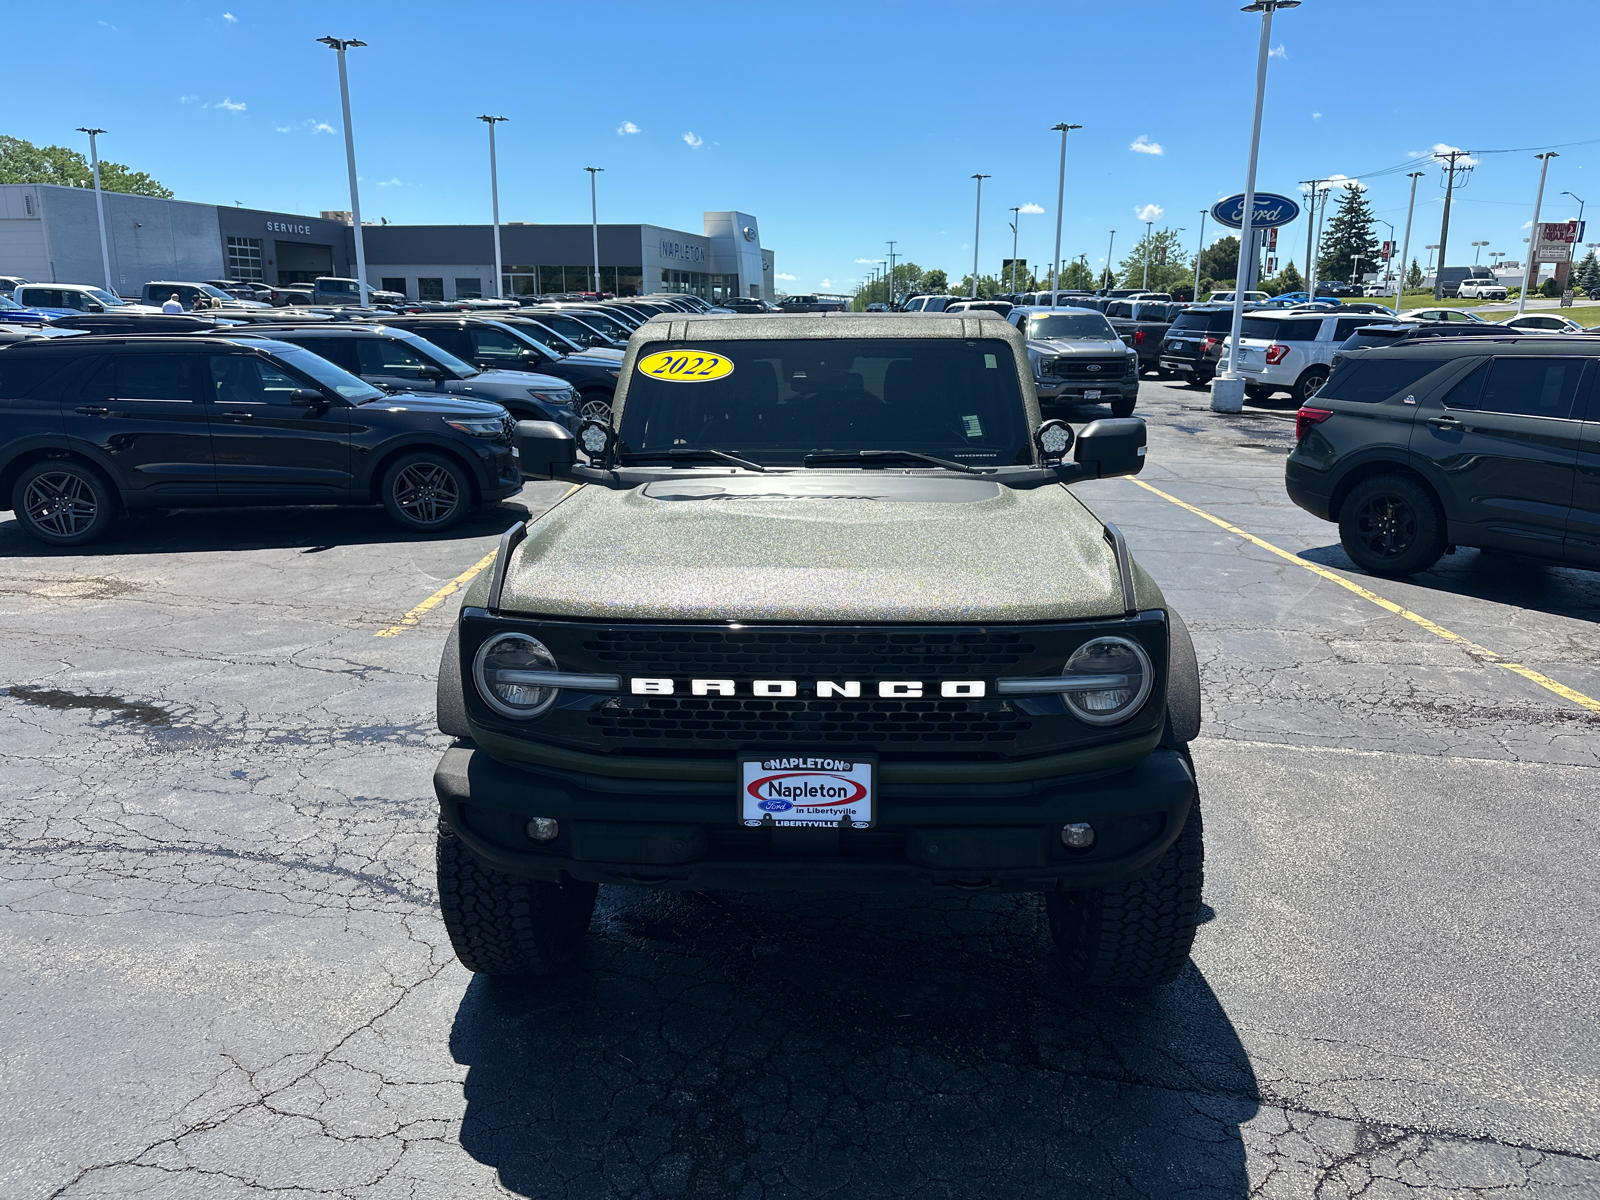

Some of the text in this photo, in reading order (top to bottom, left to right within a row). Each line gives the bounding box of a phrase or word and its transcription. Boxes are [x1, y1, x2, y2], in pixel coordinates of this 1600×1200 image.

[267, 221, 310, 235] SERVICE
[1542, 231, 1566, 242] SQUAR
[661, 239, 705, 263] NAPLETON
[651, 356, 719, 376] 2022
[631, 677, 986, 698] BRONCO
[770, 758, 845, 771] NAPLETON
[768, 781, 848, 801] Napleton
[765, 801, 786, 810] Ford
[807, 807, 857, 815] Libertyville
[775, 820, 839, 828] LIBERTYVILLE
